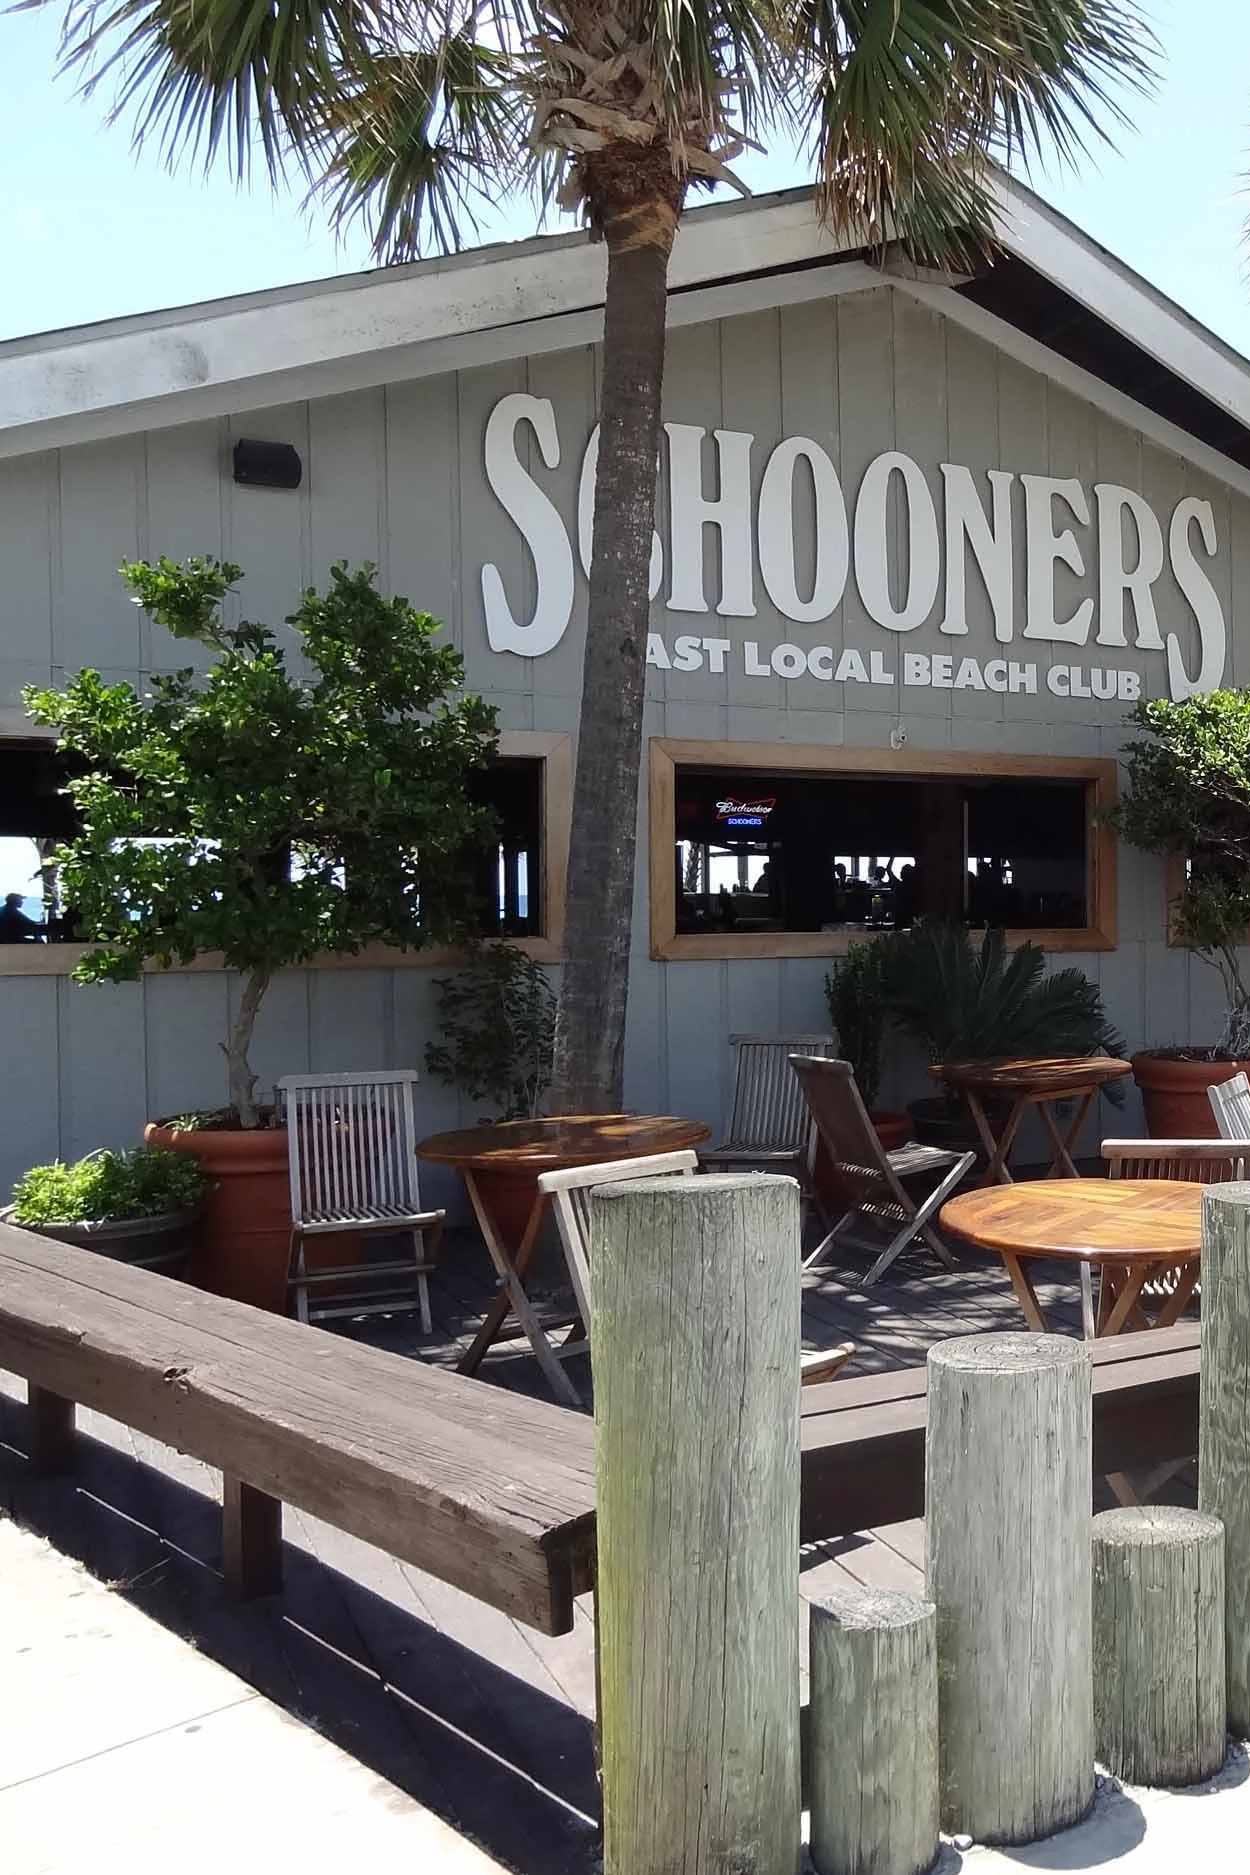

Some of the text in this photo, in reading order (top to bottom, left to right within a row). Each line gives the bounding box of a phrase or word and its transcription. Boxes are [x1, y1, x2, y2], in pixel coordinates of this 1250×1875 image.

[743, 641, 895, 685] LOCAL
[902, 652, 1039, 694] BEACH
[1046, 665, 1142, 701] CLUB
[715, 801, 773, 813] Budweiser
